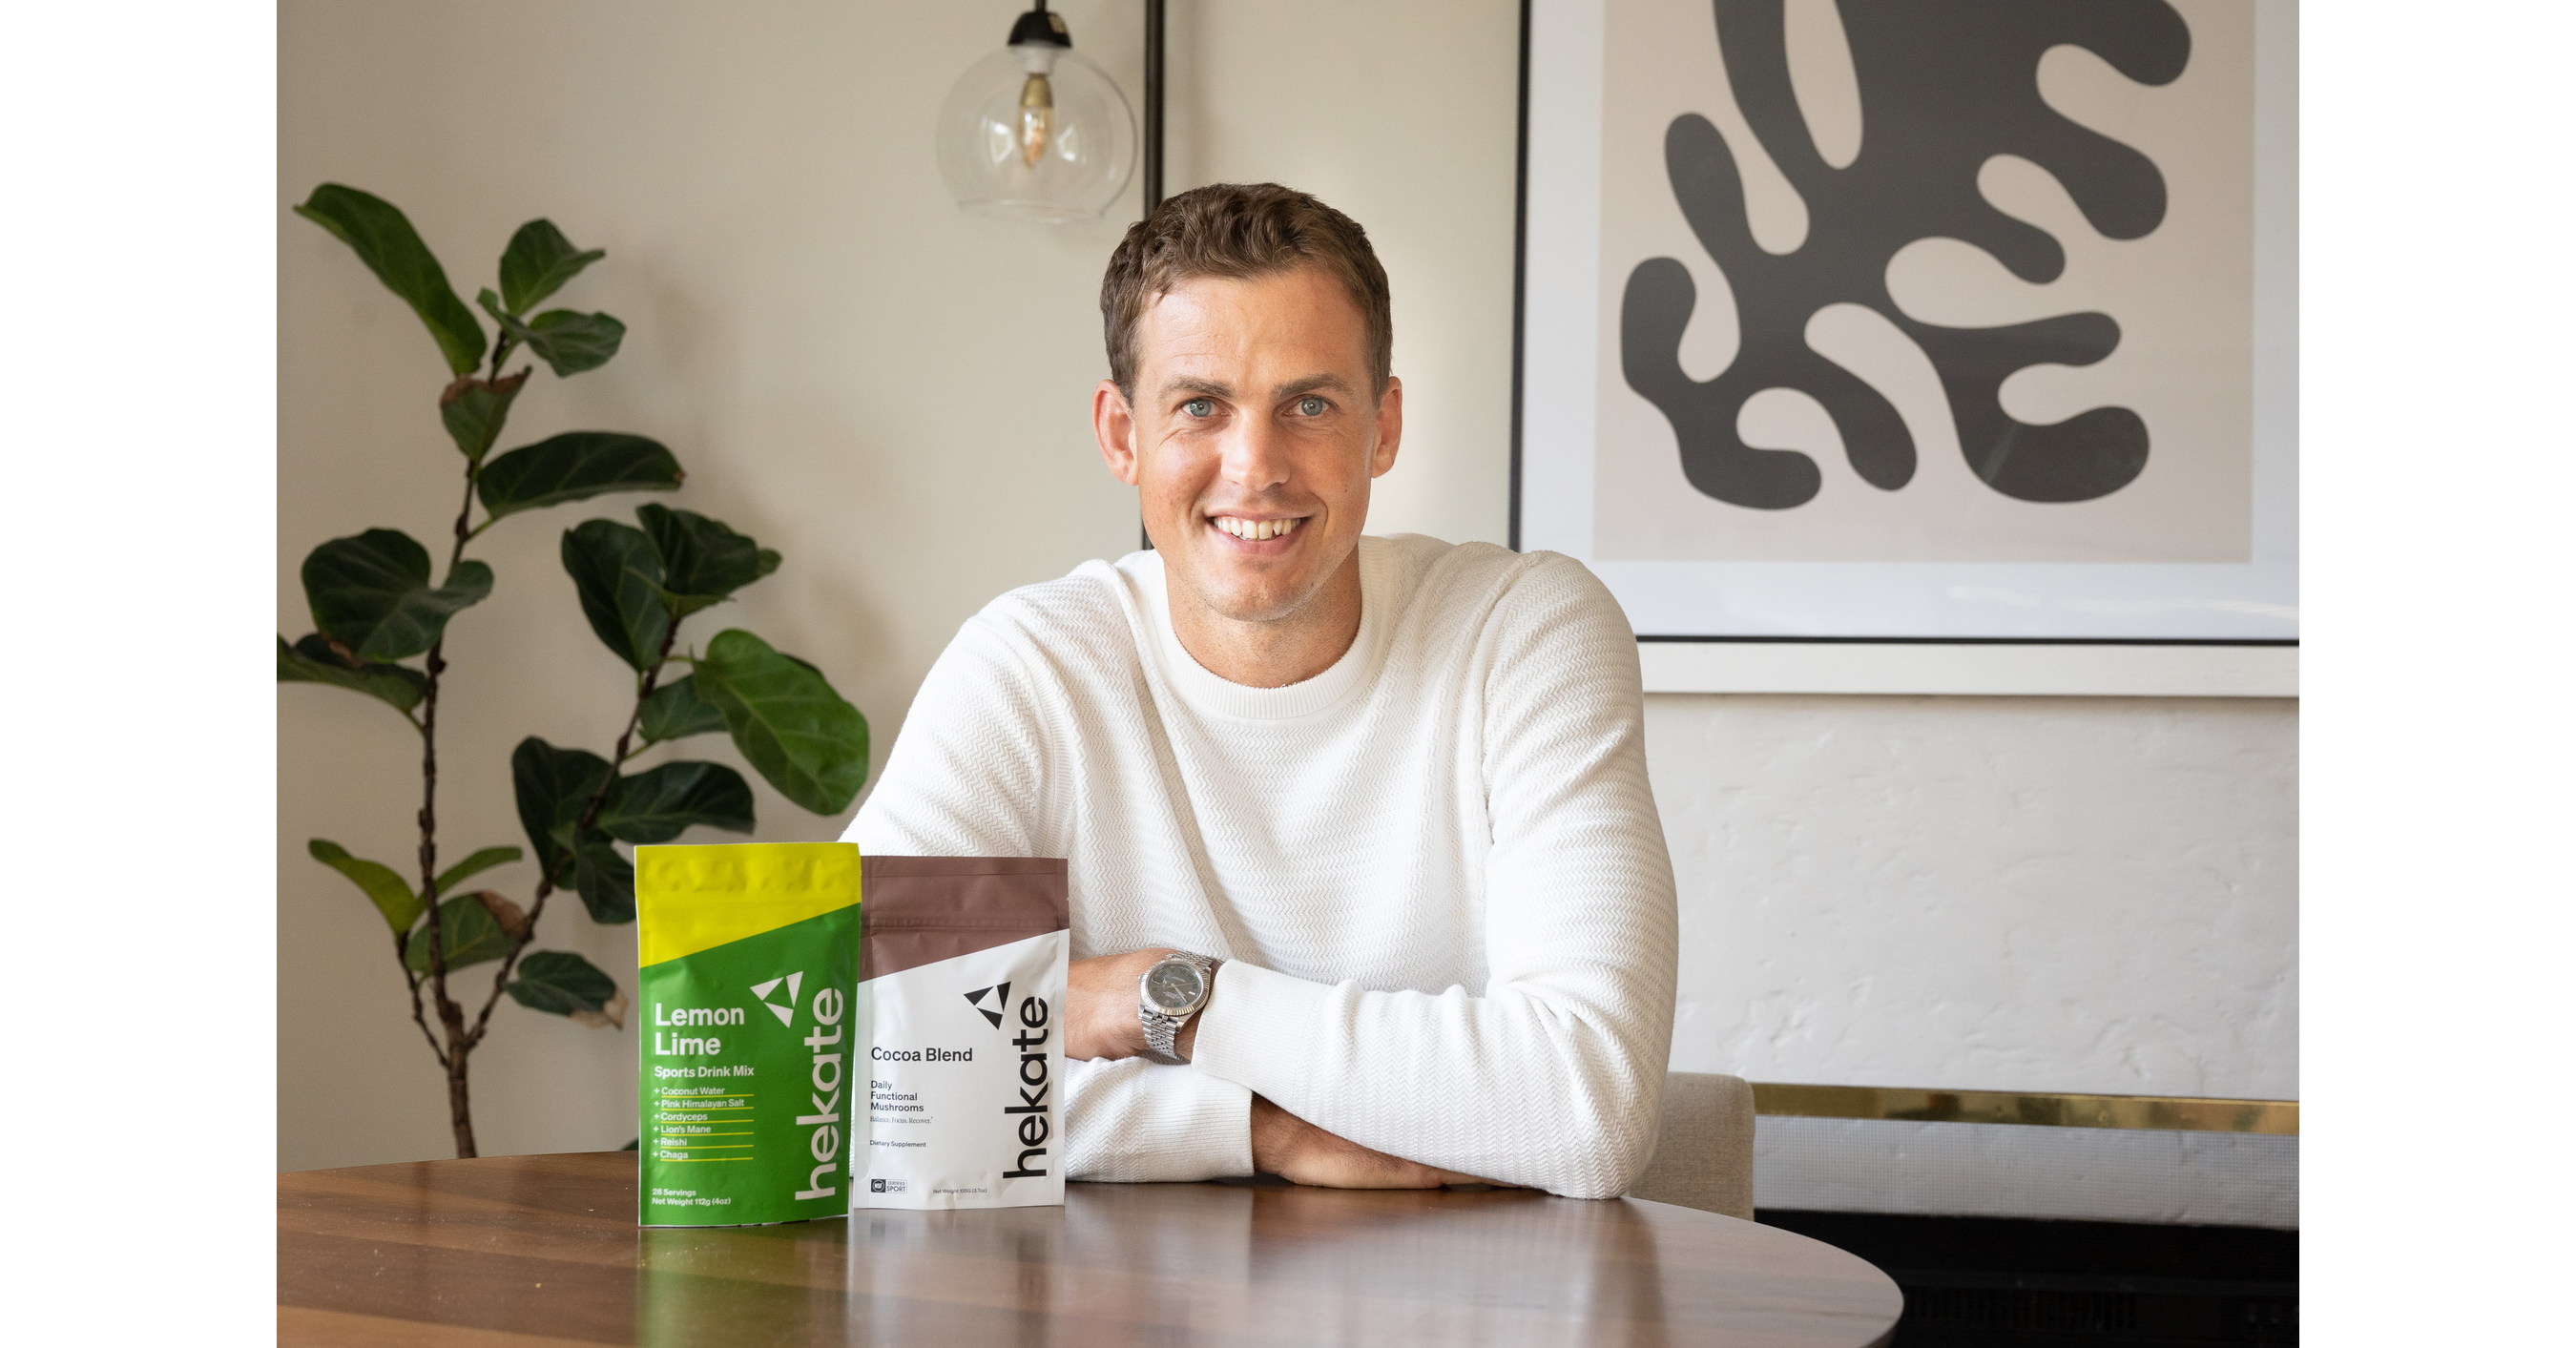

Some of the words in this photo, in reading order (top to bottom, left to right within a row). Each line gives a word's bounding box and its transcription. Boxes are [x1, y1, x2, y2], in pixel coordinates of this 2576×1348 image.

[654, 1003, 745, 1027] Lemon
[654, 1032, 721, 1055] Lime
[871, 1047, 922, 1062] Cocoa
[925, 1047, 973, 1062] Blend
[654, 1066, 696, 1080] Sports
[697, 1067, 731, 1078] Drink
[733, 1066, 755, 1077] Mix
[870, 1080, 893, 1090] Daily
[1003, 996, 1049, 1179] hekate
[661, 1087, 698, 1095] Coconut
[699, 1087, 725, 1095] Water
[795, 987, 843, 1200] hekate
[870, 1090, 918, 1101] Functional
[661, 1099, 681, 1109] Pink
[682, 1099, 727, 1110] Himalayan
[728, 1098, 745, 1108] Salt
[870, 1102, 924, 1112] Mushrooms
[660, 1111, 708, 1122] Cordyceps
[660, 1125, 686, 1133] Lion's
[686, 1125, 712, 1133] Mane
[659, 1136, 687, 1147] Reishi
[869, 1139, 890, 1148] Dietary
[890, 1140, 927, 1149] Supplement
[659, 1150, 689, 1160] Chaga
[663, 1189, 696, 1197] Servings
[666, 1197, 694, 1207] Weight
[695, 1198, 711, 1207] 112g
[711, 1197, 732, 1206] (4oz)
